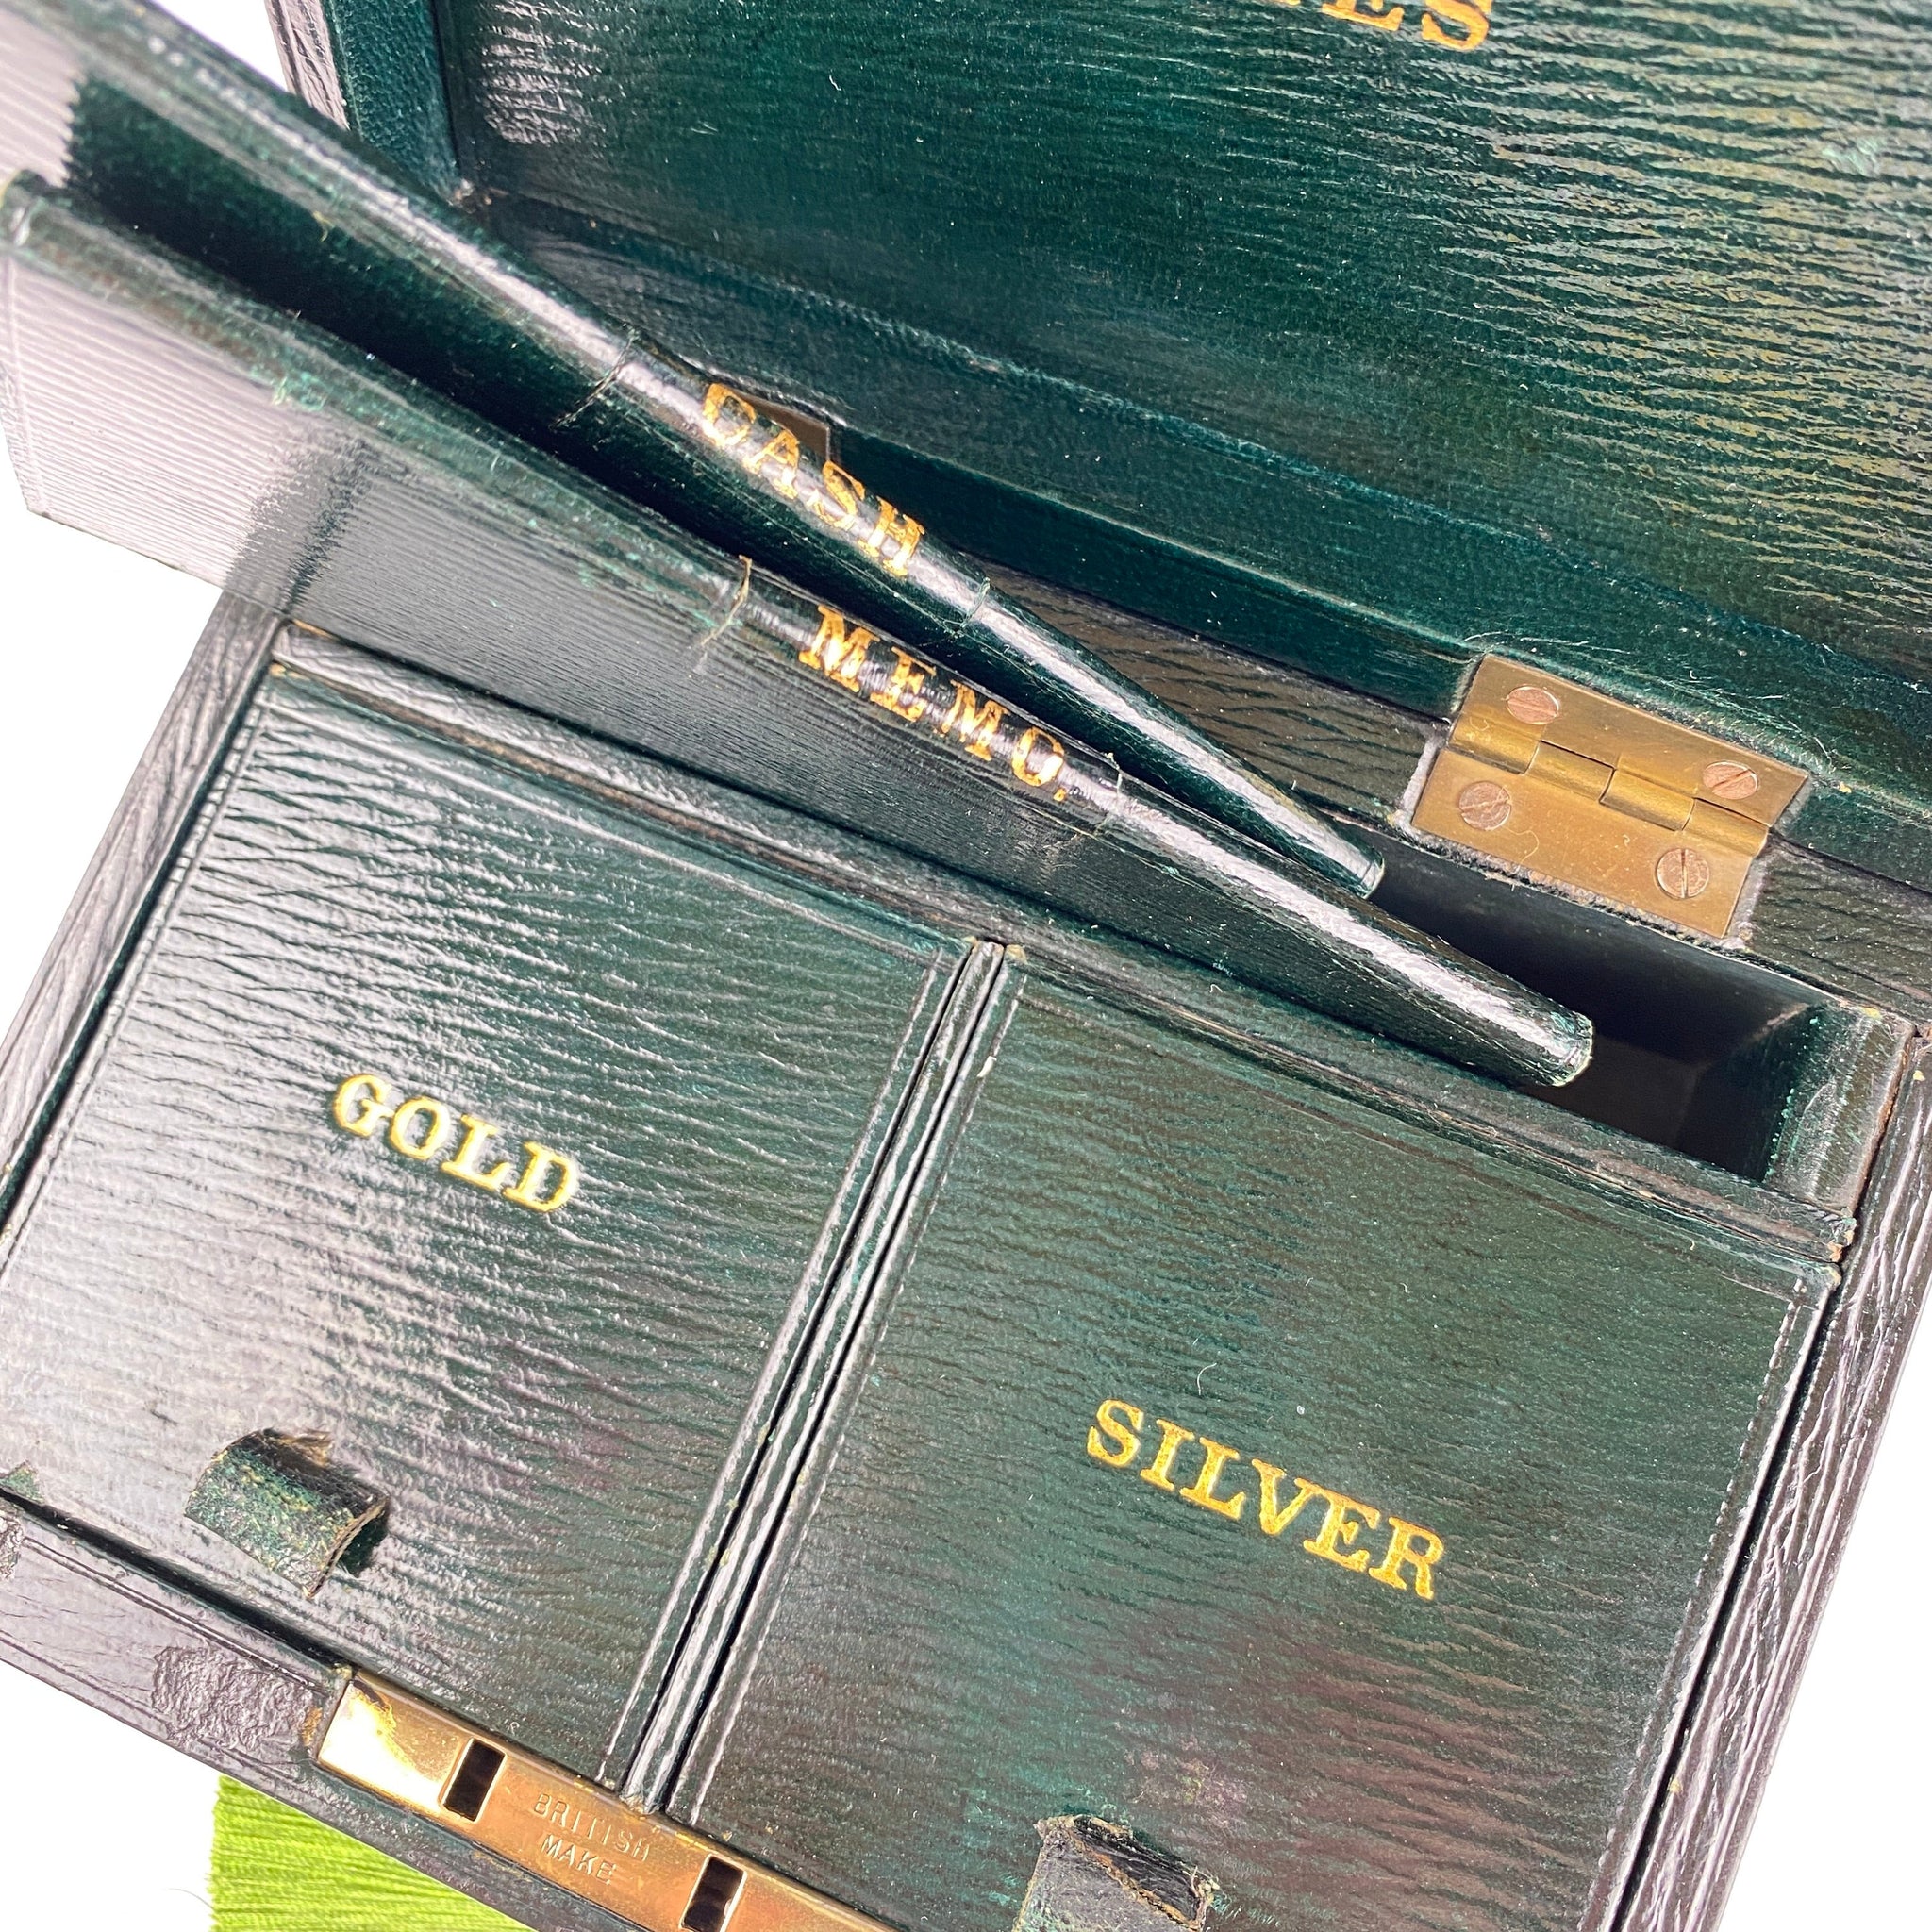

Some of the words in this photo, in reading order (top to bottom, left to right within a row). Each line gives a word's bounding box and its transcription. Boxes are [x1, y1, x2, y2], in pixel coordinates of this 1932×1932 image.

[702, 383, 925, 576] CASH
[333, 1074, 579, 1213] GOLD
[1087, 1399, 1445, 1600] SILVER
[533, 1793, 650, 1862] BRITISH
[541, 1834, 617, 1885] MAKE
